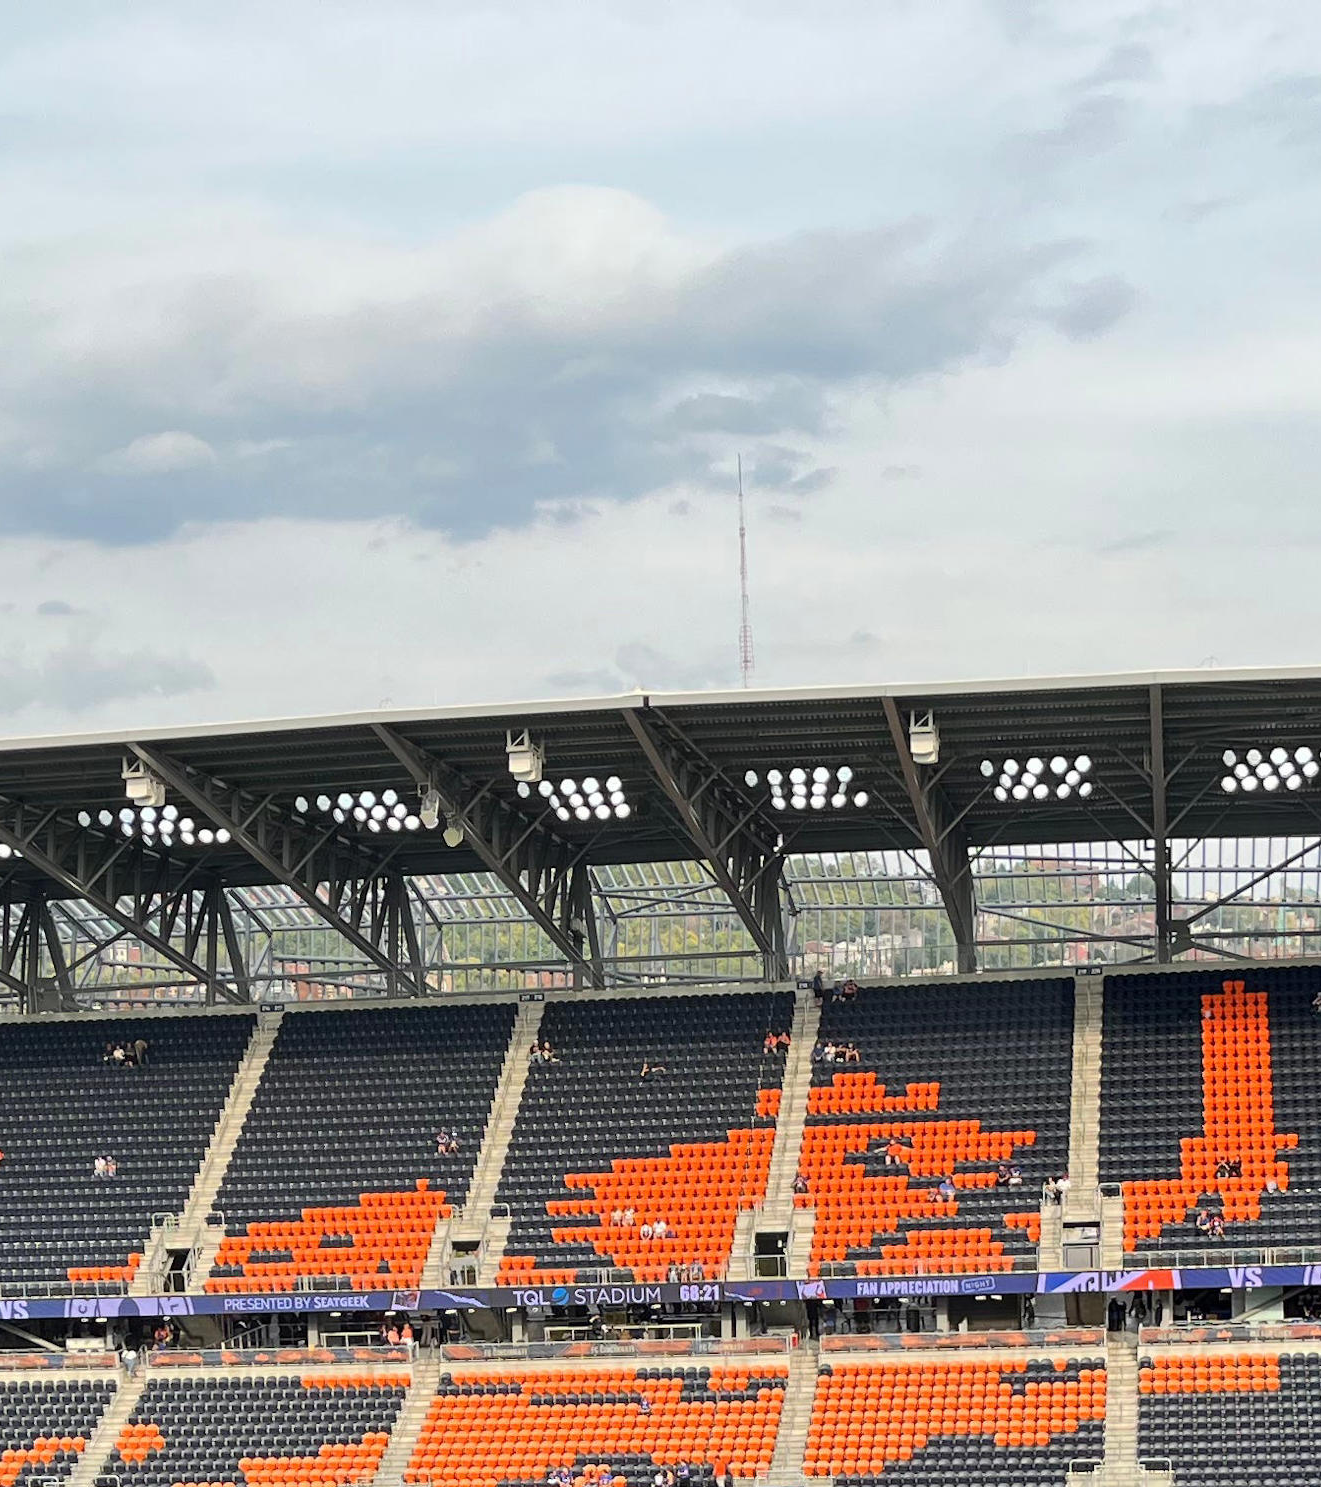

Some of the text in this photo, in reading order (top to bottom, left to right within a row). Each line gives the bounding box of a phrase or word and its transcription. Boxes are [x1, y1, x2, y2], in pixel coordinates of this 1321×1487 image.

[1229, 1267, 1263, 1288] VS
[512, 1286, 662, 1306] TQL STADIUM
[857, 1279, 990, 1296] FAN APPRECIATION NIGHT
[224, 1295, 370, 1311] PRESENTED BY SEATGEEK
